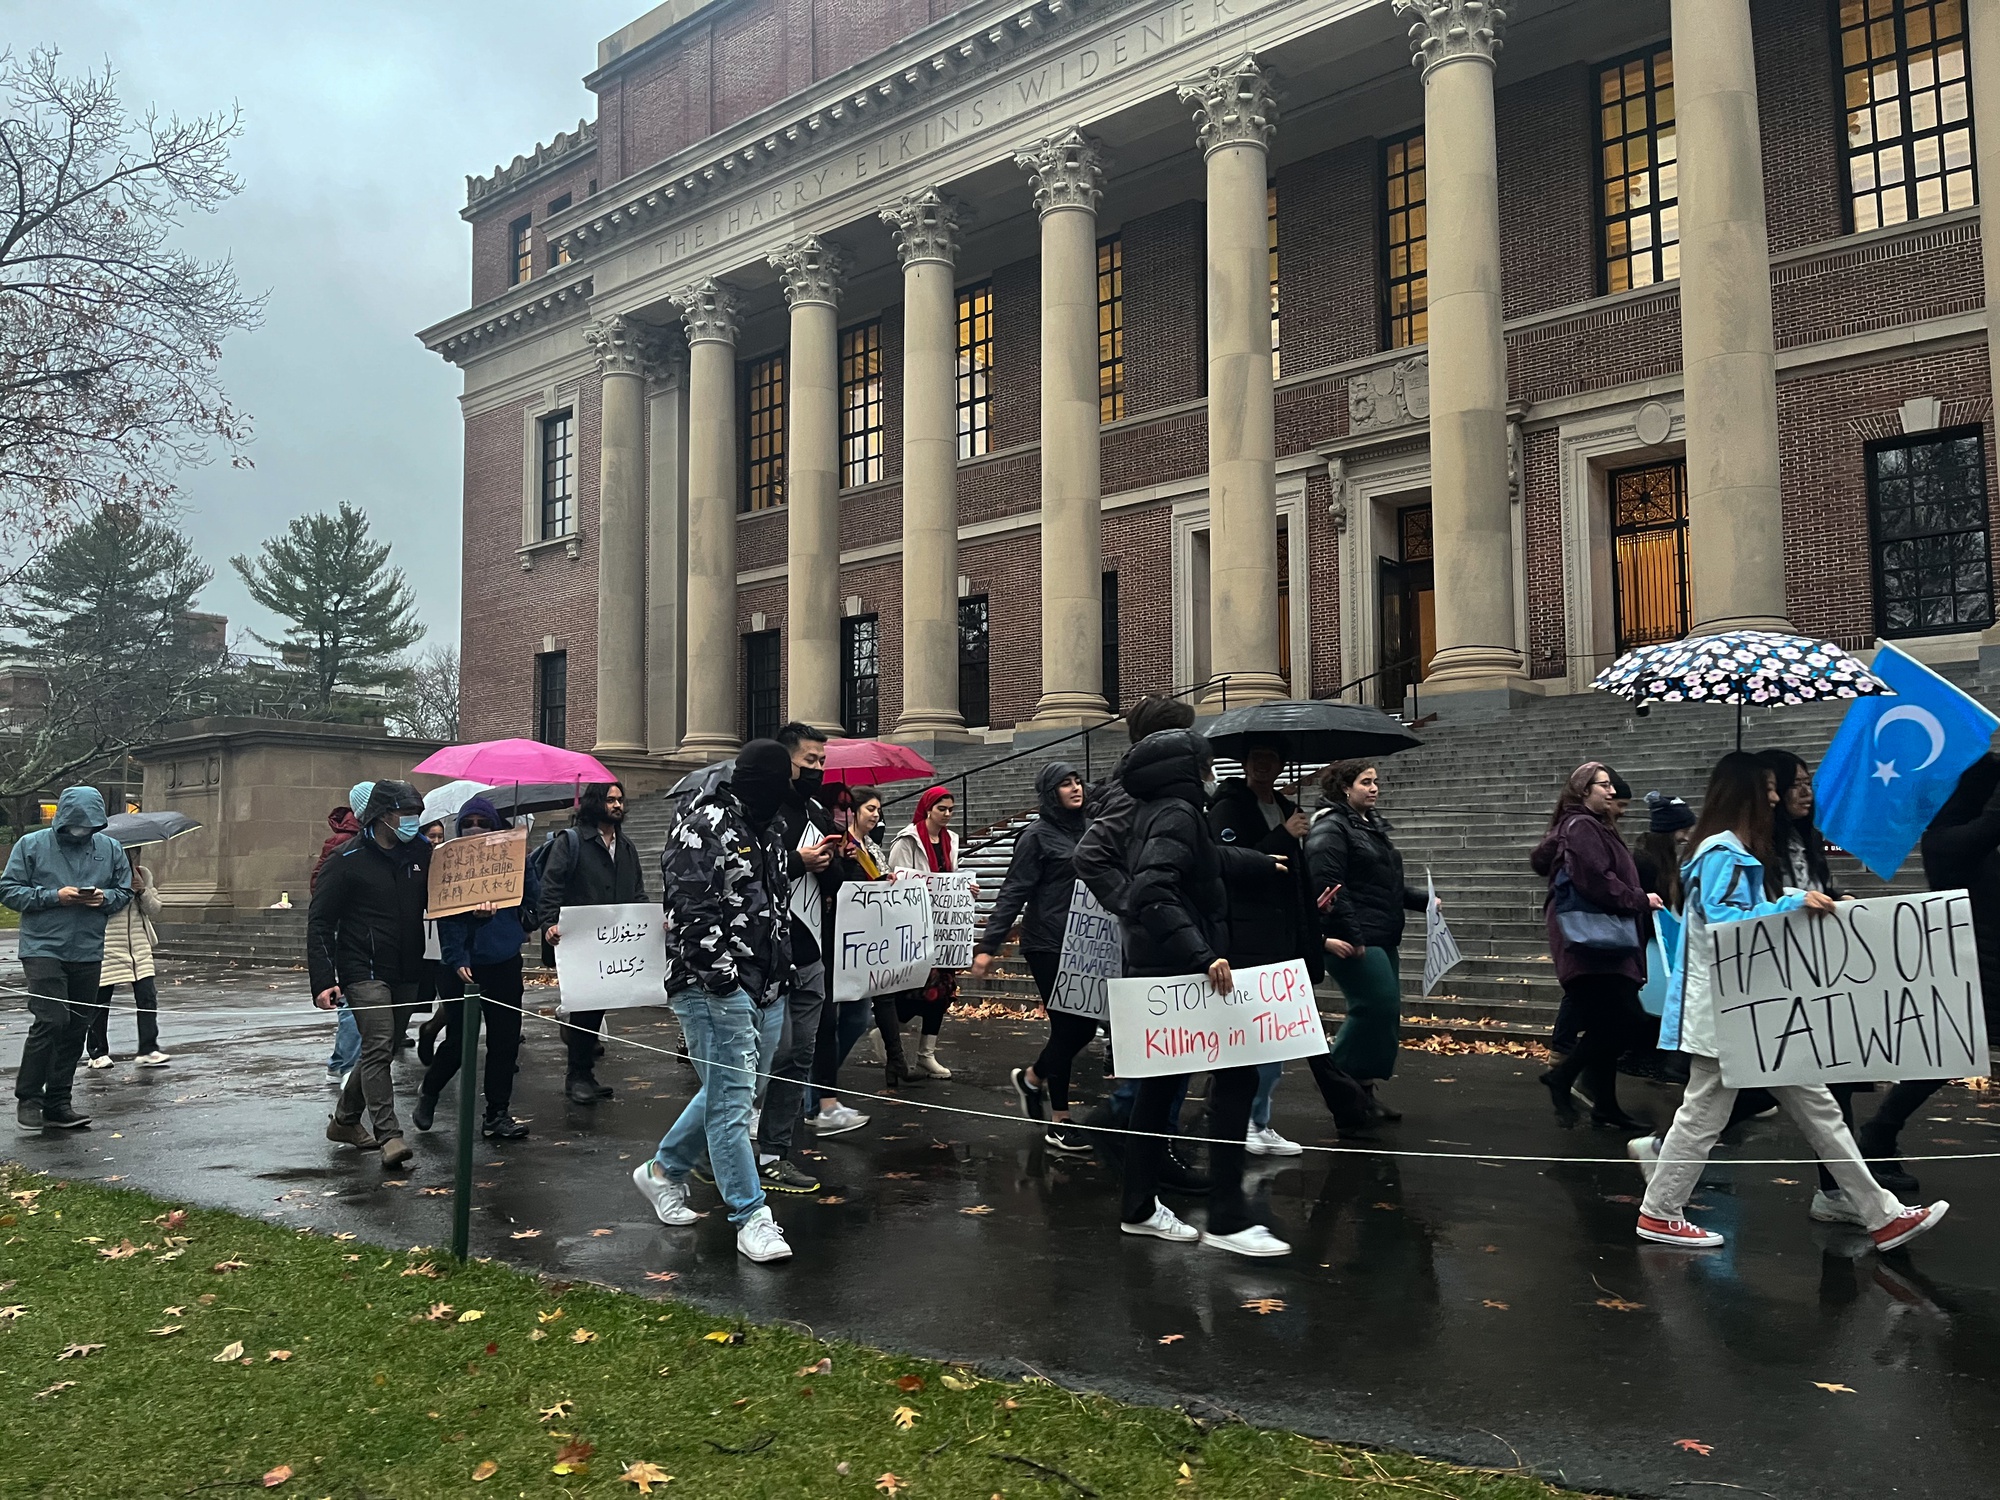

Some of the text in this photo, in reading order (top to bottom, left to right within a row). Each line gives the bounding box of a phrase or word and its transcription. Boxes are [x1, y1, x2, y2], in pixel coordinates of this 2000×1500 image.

[655, 0, 1236, 264] THE HARRY ELKINS WIDENER
[929, 894, 972, 909] ORCED LABOR
[937, 877, 951, 892] THE
[842, 931, 890, 970] Free
[1710, 895, 1970, 997] HANDS OFF
[1147, 980, 1215, 1016] STOP
[1222, 986, 1253, 1006] the
[1145, 1005, 1316, 1063] Killing in Tibet!
[1721, 980, 1976, 1072] TAIWAN
